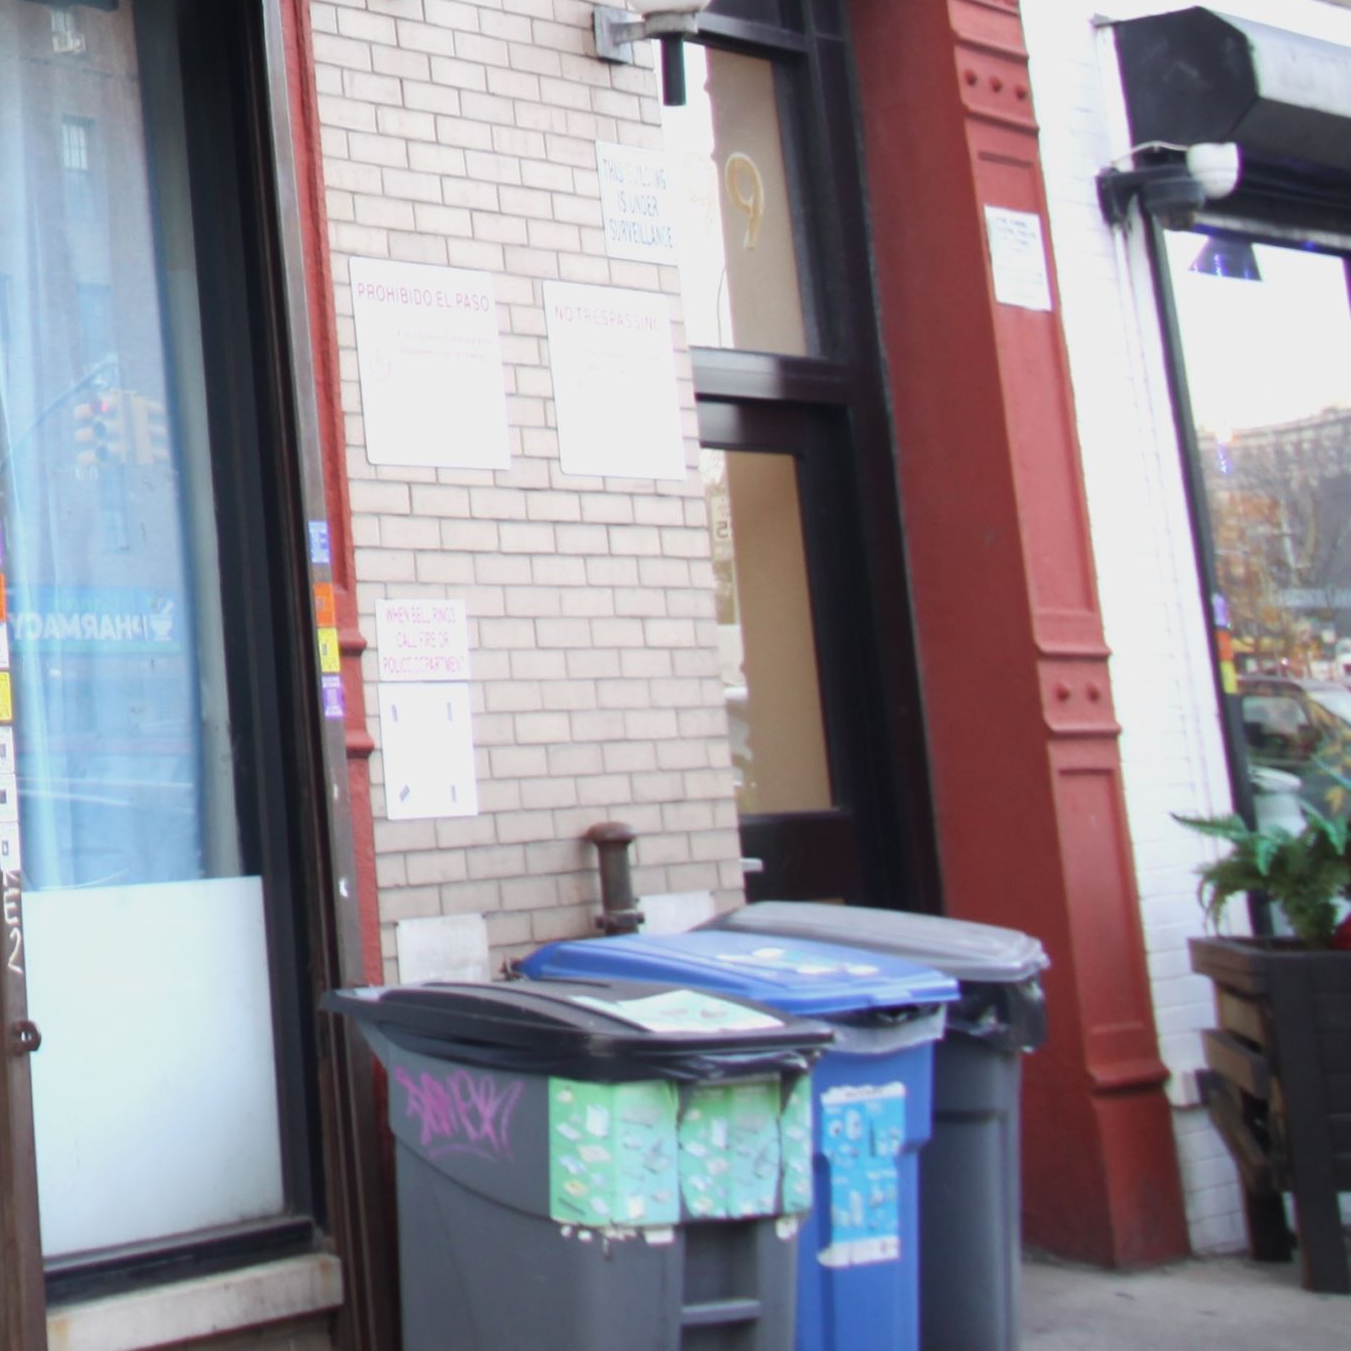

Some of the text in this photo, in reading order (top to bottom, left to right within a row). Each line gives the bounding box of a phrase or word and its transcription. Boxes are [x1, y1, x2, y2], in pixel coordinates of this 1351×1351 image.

[357, 282, 490, 313] PROHIBIDO EL PASO
[554, 305, 573, 322] NO
